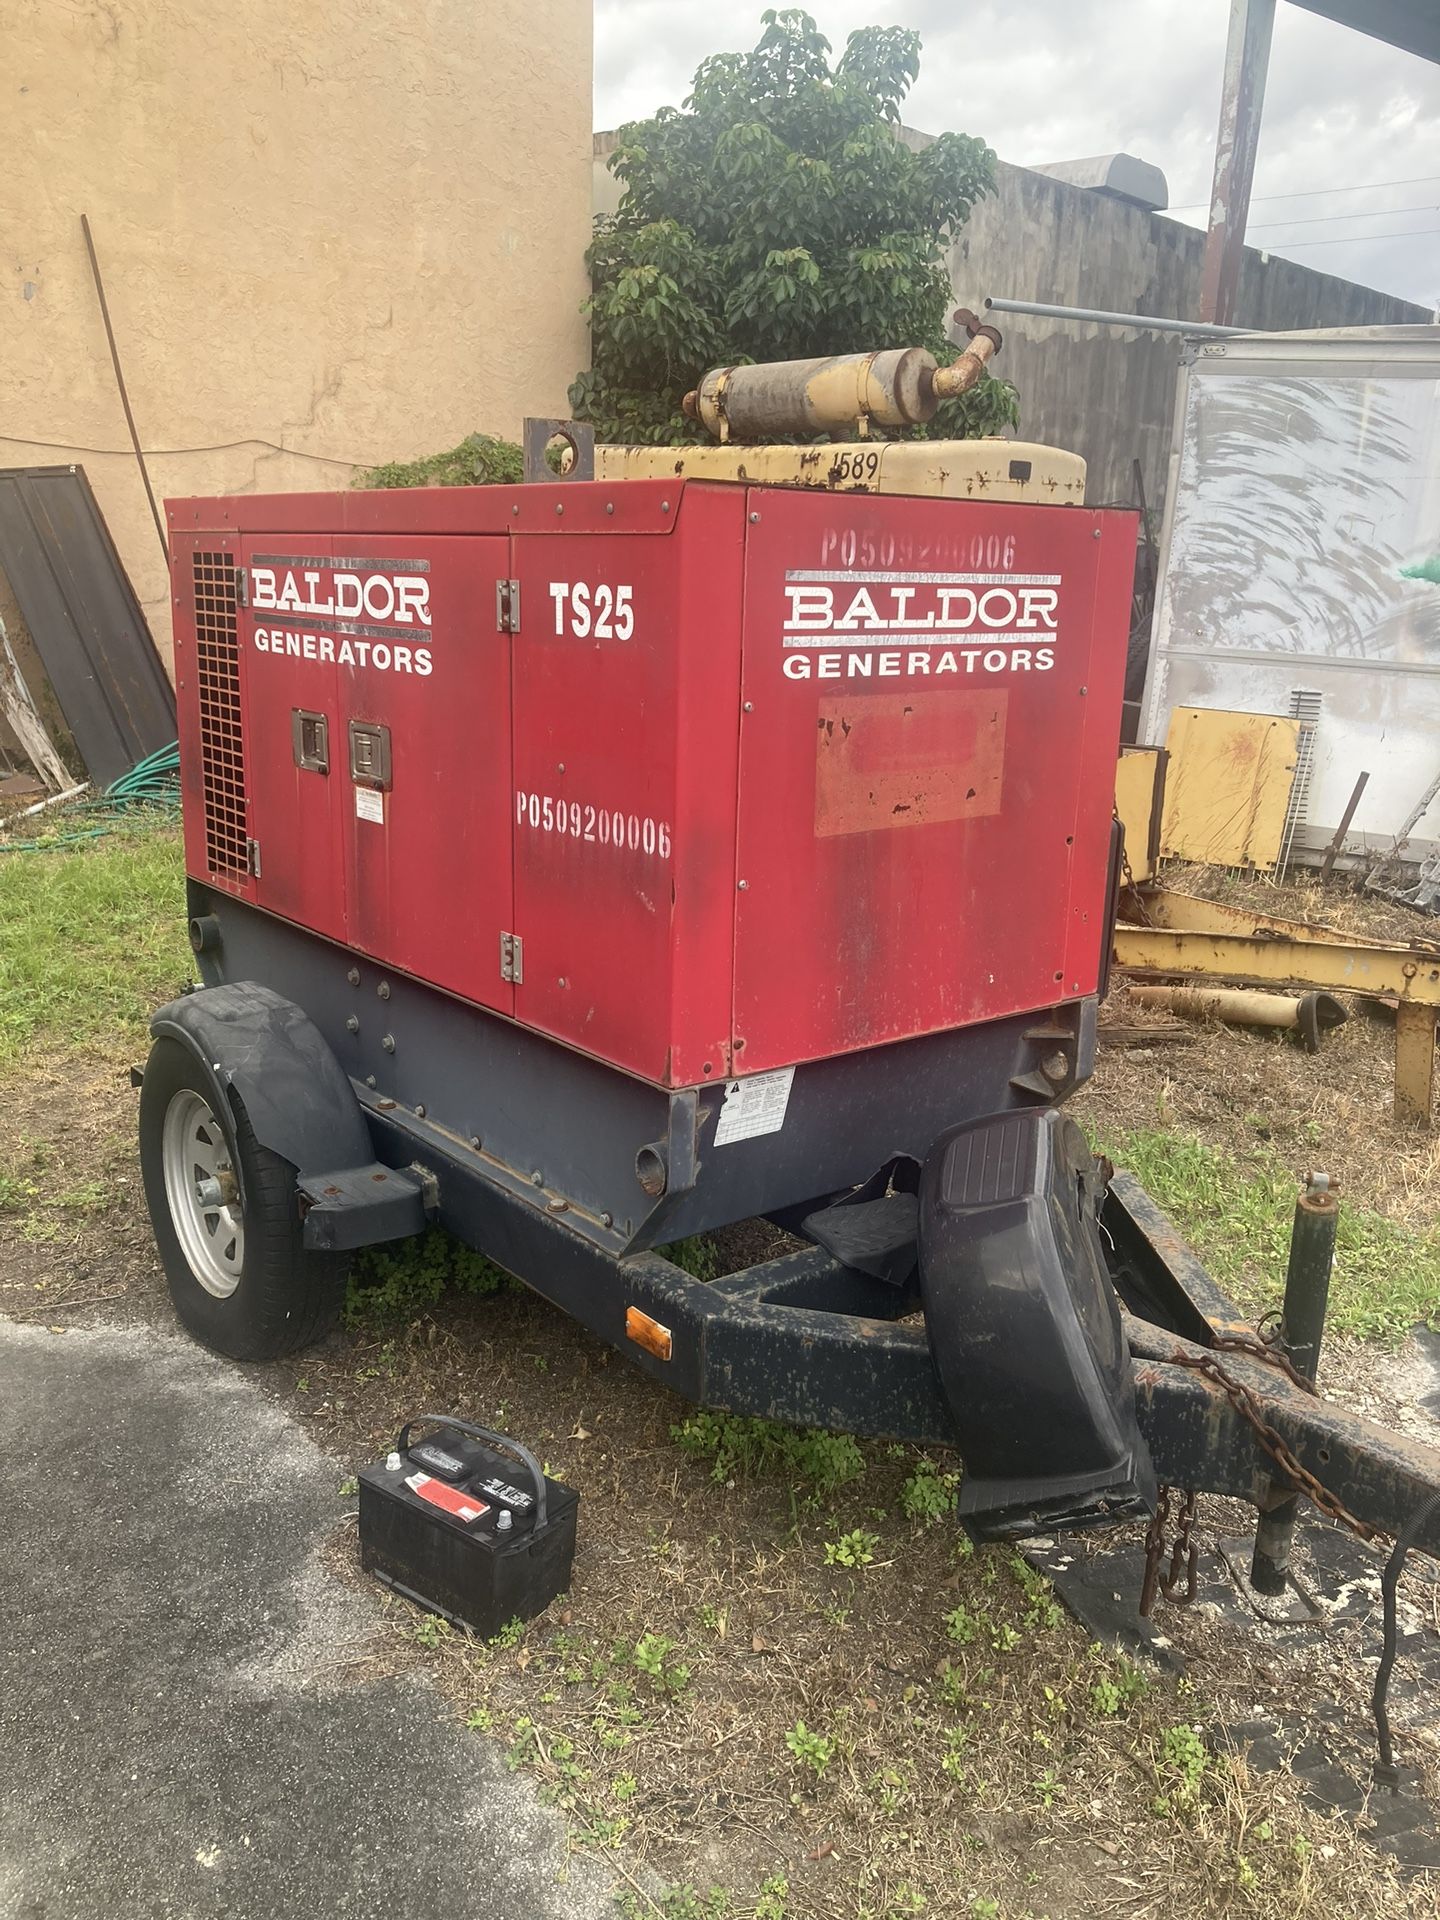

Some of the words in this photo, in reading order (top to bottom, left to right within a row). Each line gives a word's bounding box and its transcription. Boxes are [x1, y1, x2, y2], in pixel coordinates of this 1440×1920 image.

[833, 452, 878, 480] 1589
[251, 568, 432, 625] BALDOR
[549, 582, 634, 641] TS25
[783, 586, 1059, 628] BALDOR
[254, 628, 433, 676] GENERATORS
[782, 649, 1055, 679] GENERATORS
[516, 791, 671, 859] P0509200006
